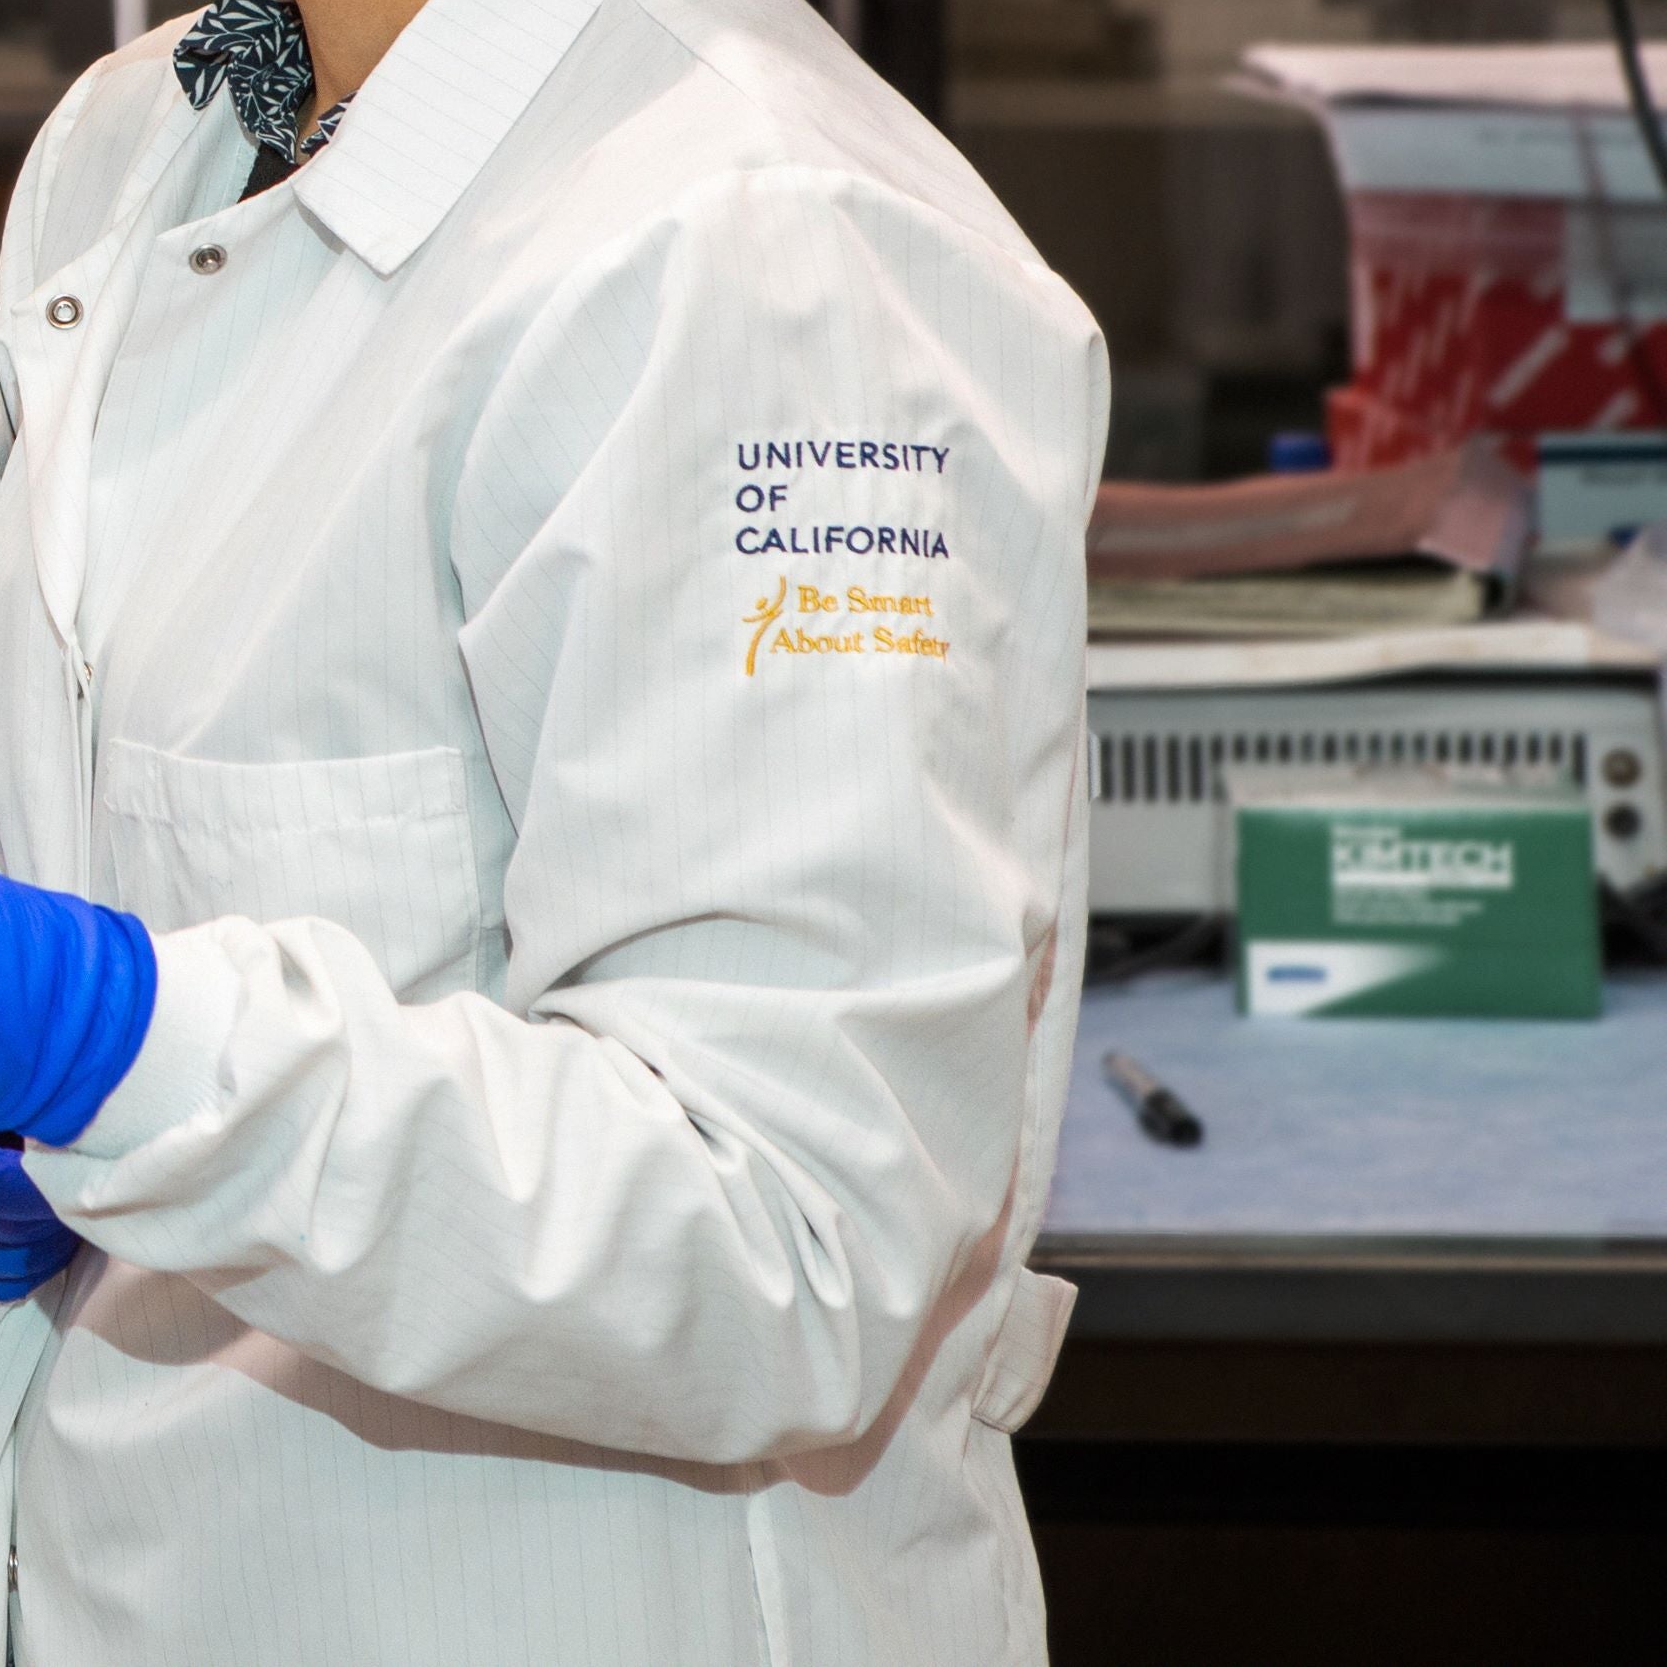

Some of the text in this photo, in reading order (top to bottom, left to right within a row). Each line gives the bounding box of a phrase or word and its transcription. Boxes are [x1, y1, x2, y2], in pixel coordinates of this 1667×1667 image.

[737, 440, 950, 473] UNIVERSITY
[735, 484, 788, 512] OF
[735, 525, 950, 559] CALIFORNIA
[797, 584, 935, 618] Be Smart
[770, 624, 951, 664] About Safety
[1332, 840, 1514, 873] KIMTECH
